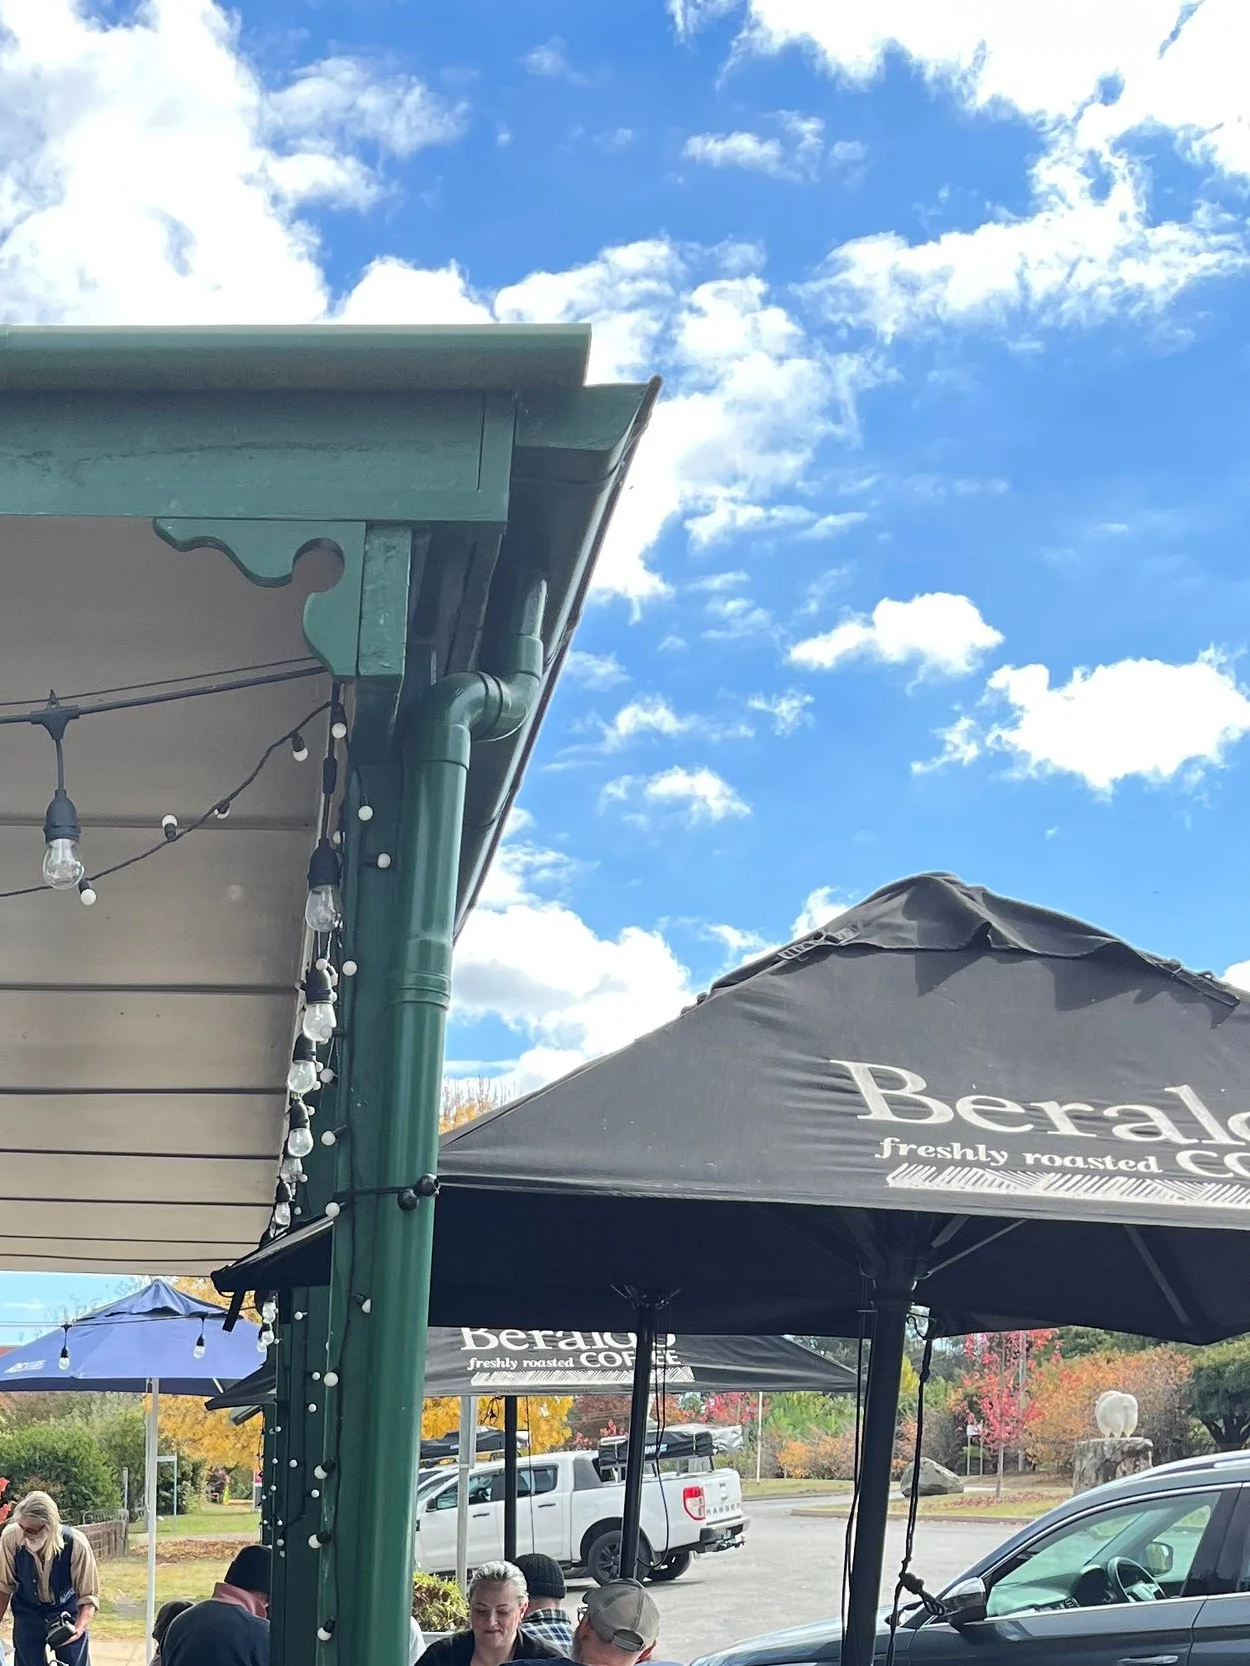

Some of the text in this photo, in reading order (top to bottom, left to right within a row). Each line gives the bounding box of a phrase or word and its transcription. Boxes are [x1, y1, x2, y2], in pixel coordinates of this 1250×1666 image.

[875, 1137, 1009, 1166] freshly
[1023, 1150, 1163, 1174] roasted
[467, 1350, 682, 1371] freshly roasted COFEE
[706, 1503, 741, 1516] RANGER
